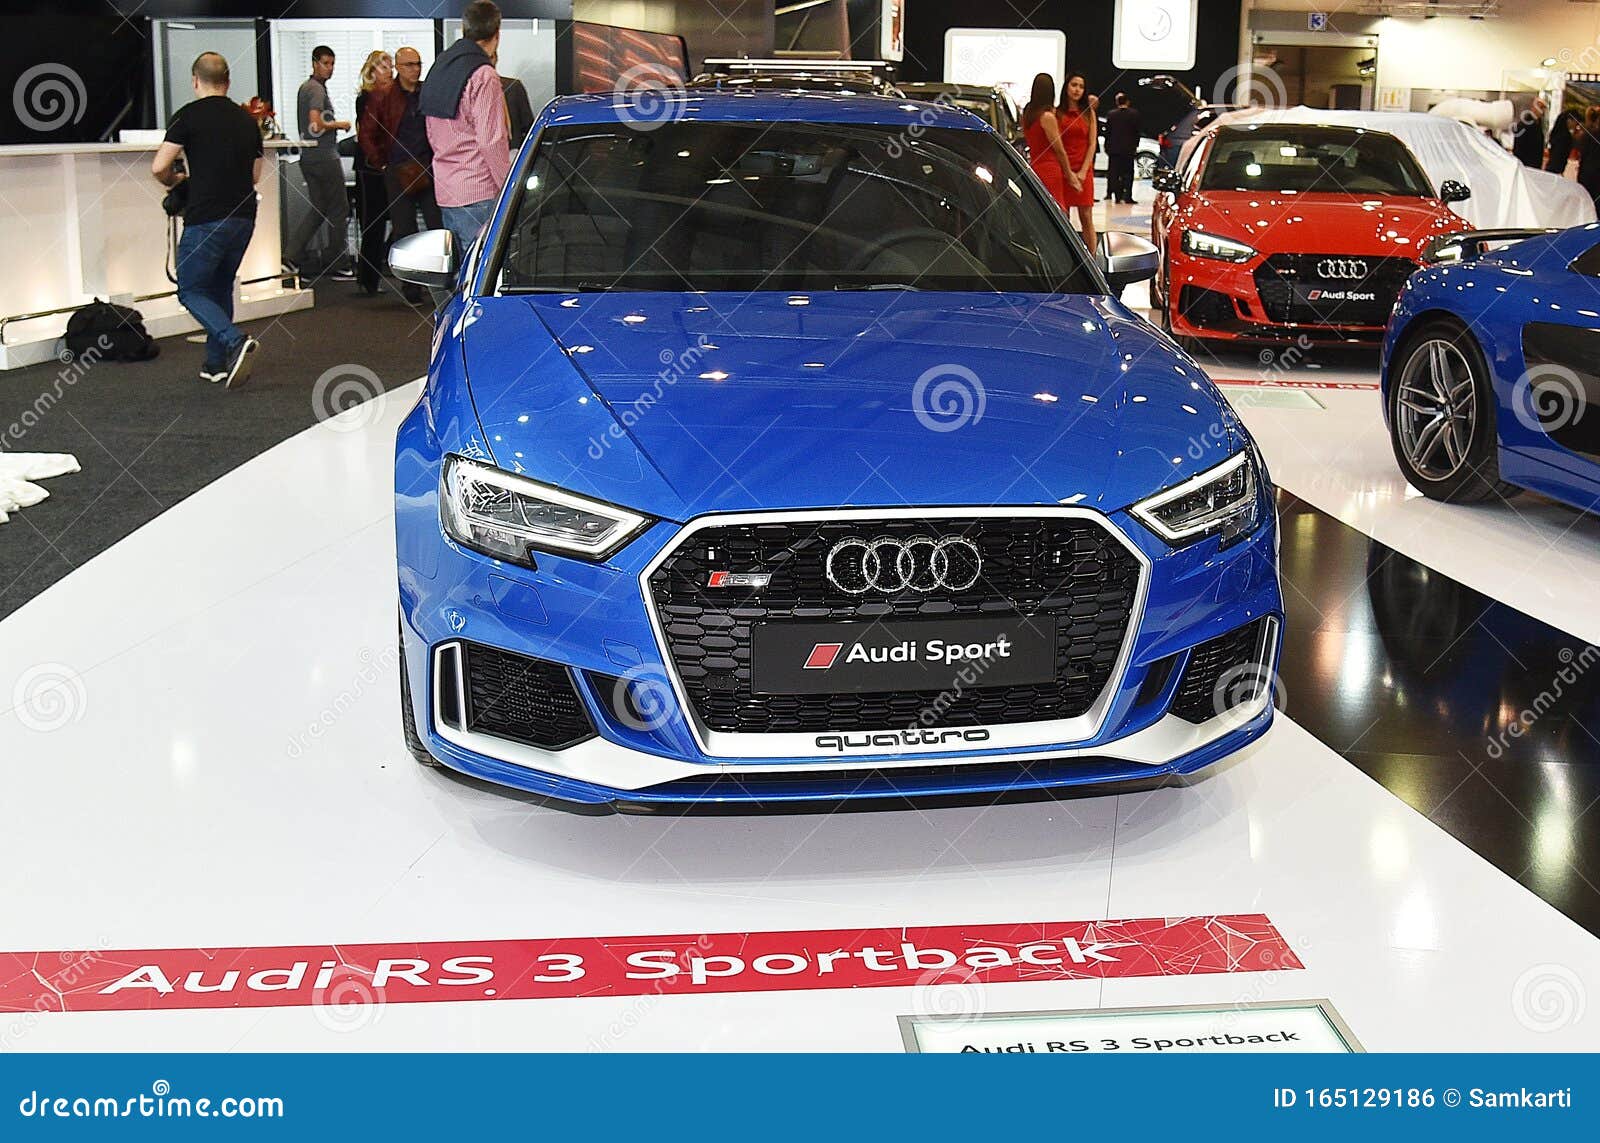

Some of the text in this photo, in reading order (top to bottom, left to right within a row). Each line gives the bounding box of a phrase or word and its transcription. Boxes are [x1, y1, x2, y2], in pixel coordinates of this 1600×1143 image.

[1321, 290, 1375, 301] Audi Sport
[845, 639, 1012, 665] Audi Sport
[815, 728, 990, 751] quattro
[98, 936, 1122, 995] Audi RS 3 Sportback
[1046, 1040, 1090, 1052] RS
[1100, 1038, 1121, 1051] 3
[1131, 1030, 1301, 1050] Sportback
